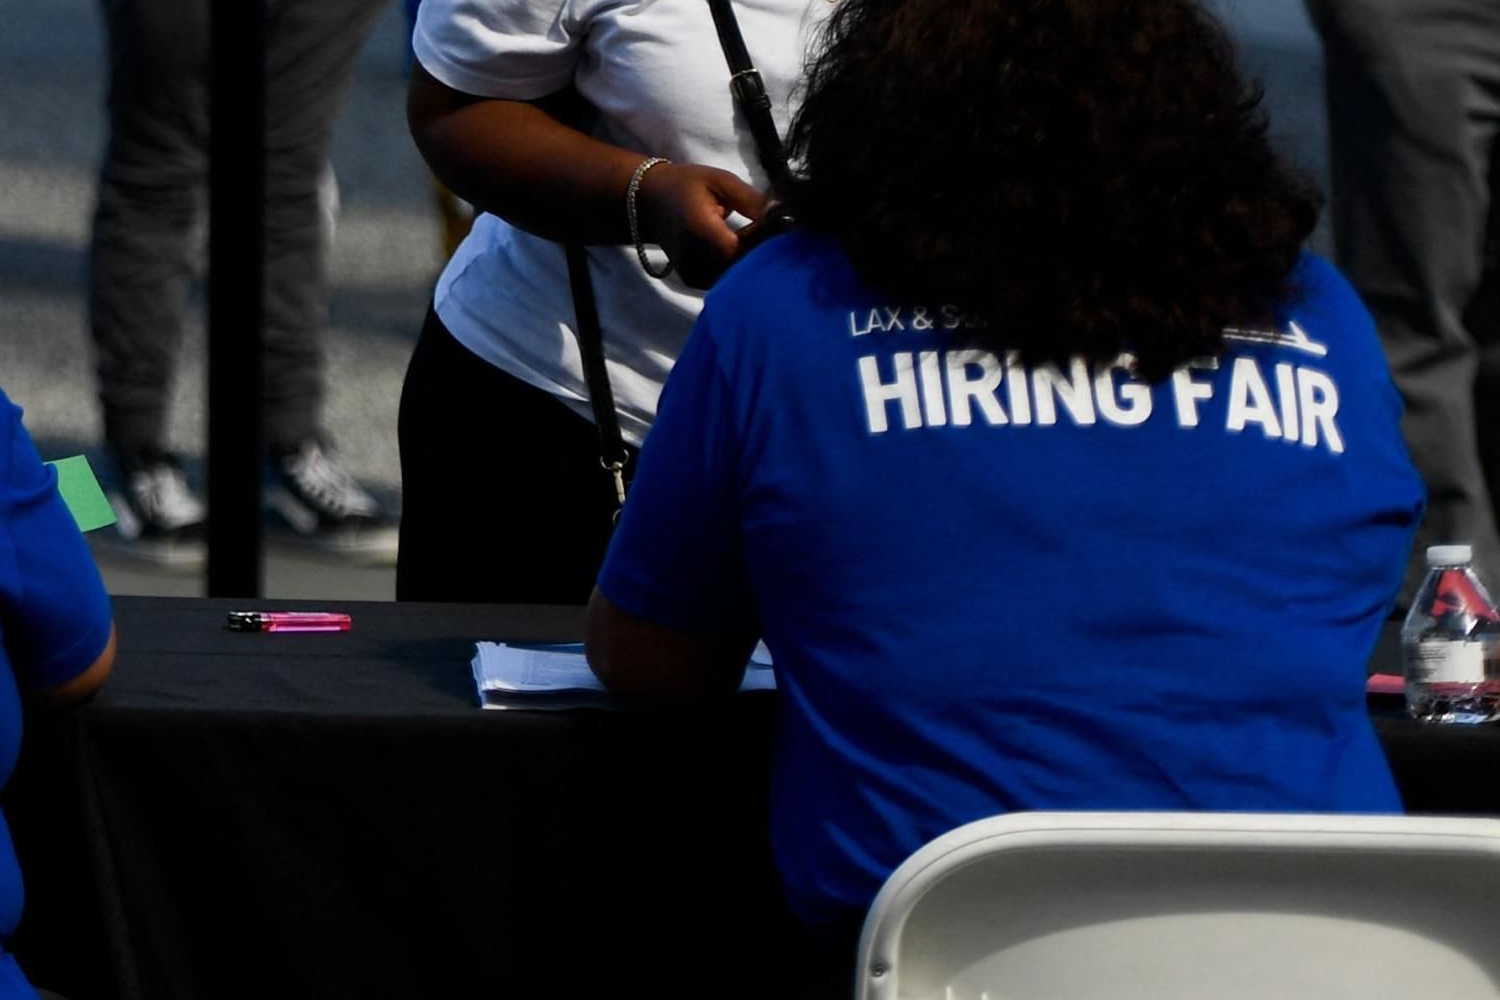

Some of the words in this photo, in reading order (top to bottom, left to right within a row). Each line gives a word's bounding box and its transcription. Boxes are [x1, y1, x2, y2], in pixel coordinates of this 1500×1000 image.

[850, 307, 902, 336] LAX
[913, 306, 934, 330] &
[857, 349, 1153, 434] HIRING
[1172, 355, 1344, 453] FAIR
